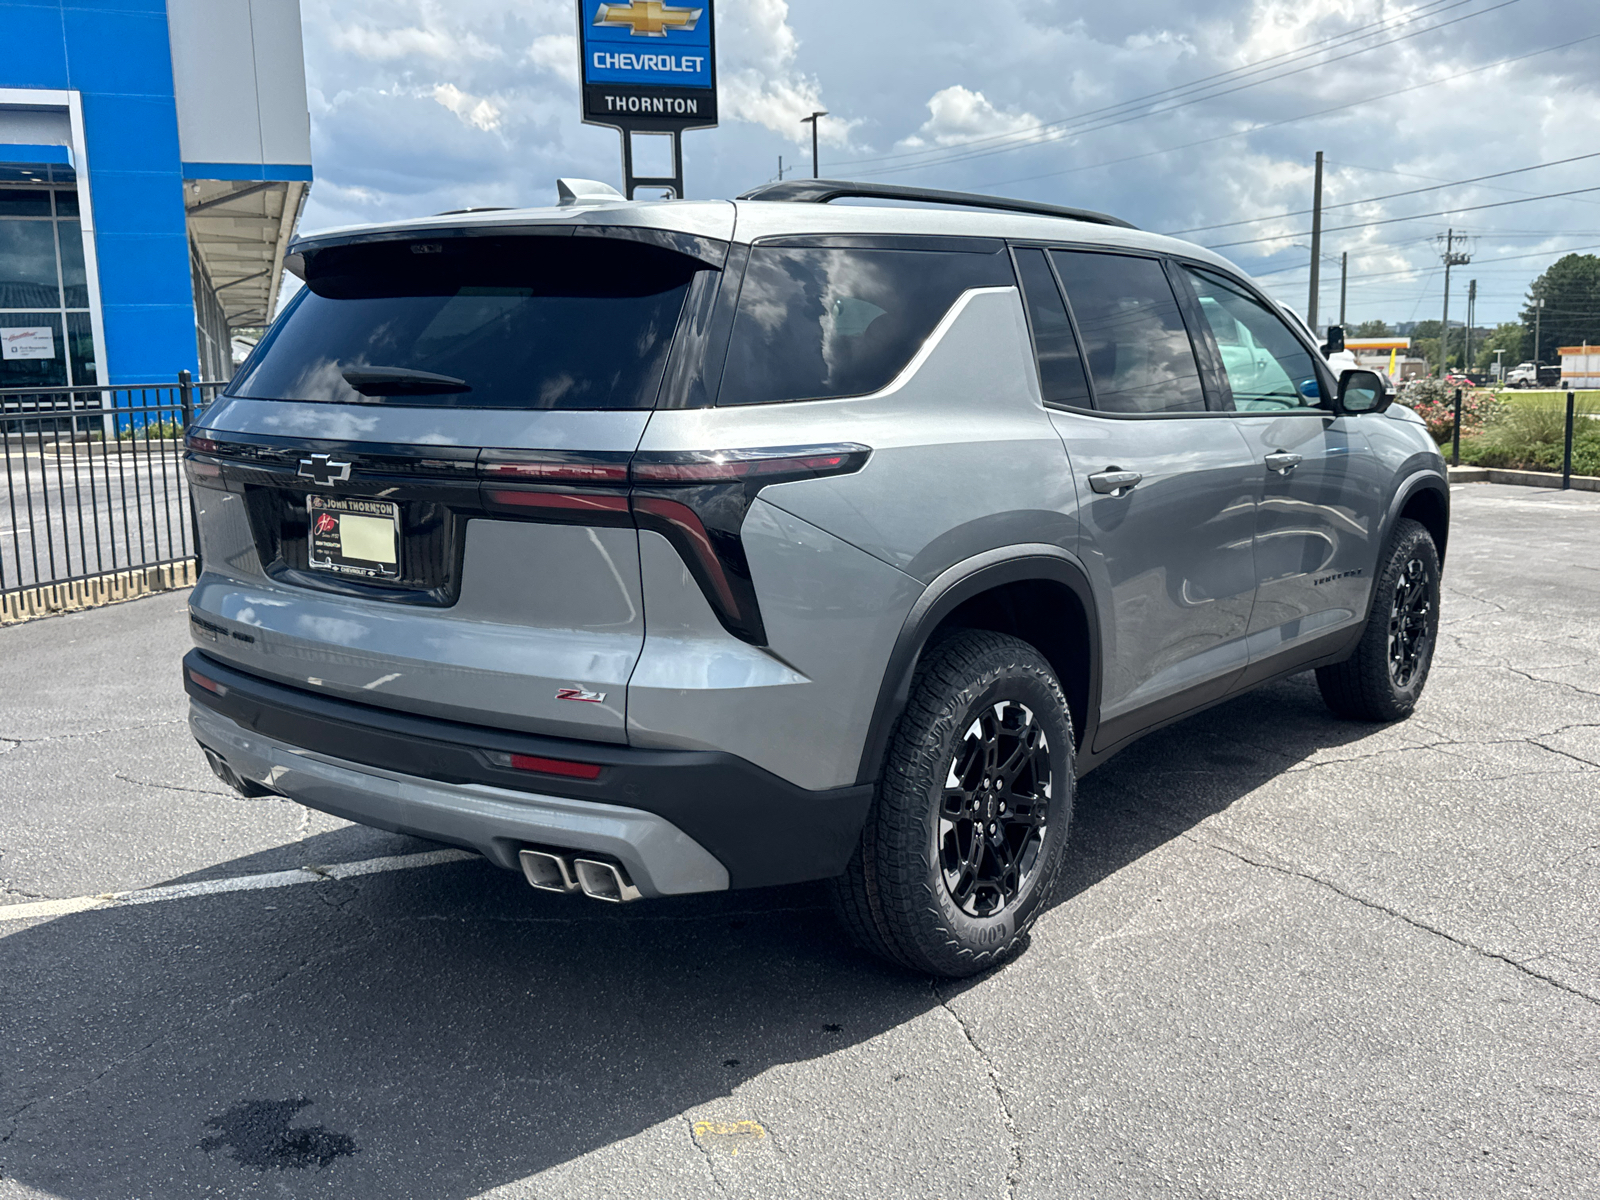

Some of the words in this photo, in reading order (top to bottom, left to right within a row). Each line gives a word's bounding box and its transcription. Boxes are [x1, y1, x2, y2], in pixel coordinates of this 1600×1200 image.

[593, 52, 704, 72] CHEVROLET
[604, 96, 698, 113] THORNTON
[327, 499, 348, 509] JOHN
[348, 502, 392, 514] THORNTON
[340, 567, 367, 575] CHEVROLET
[555, 687, 607, 703] Z71
[935, 876, 1007, 945] GOODYEAR
